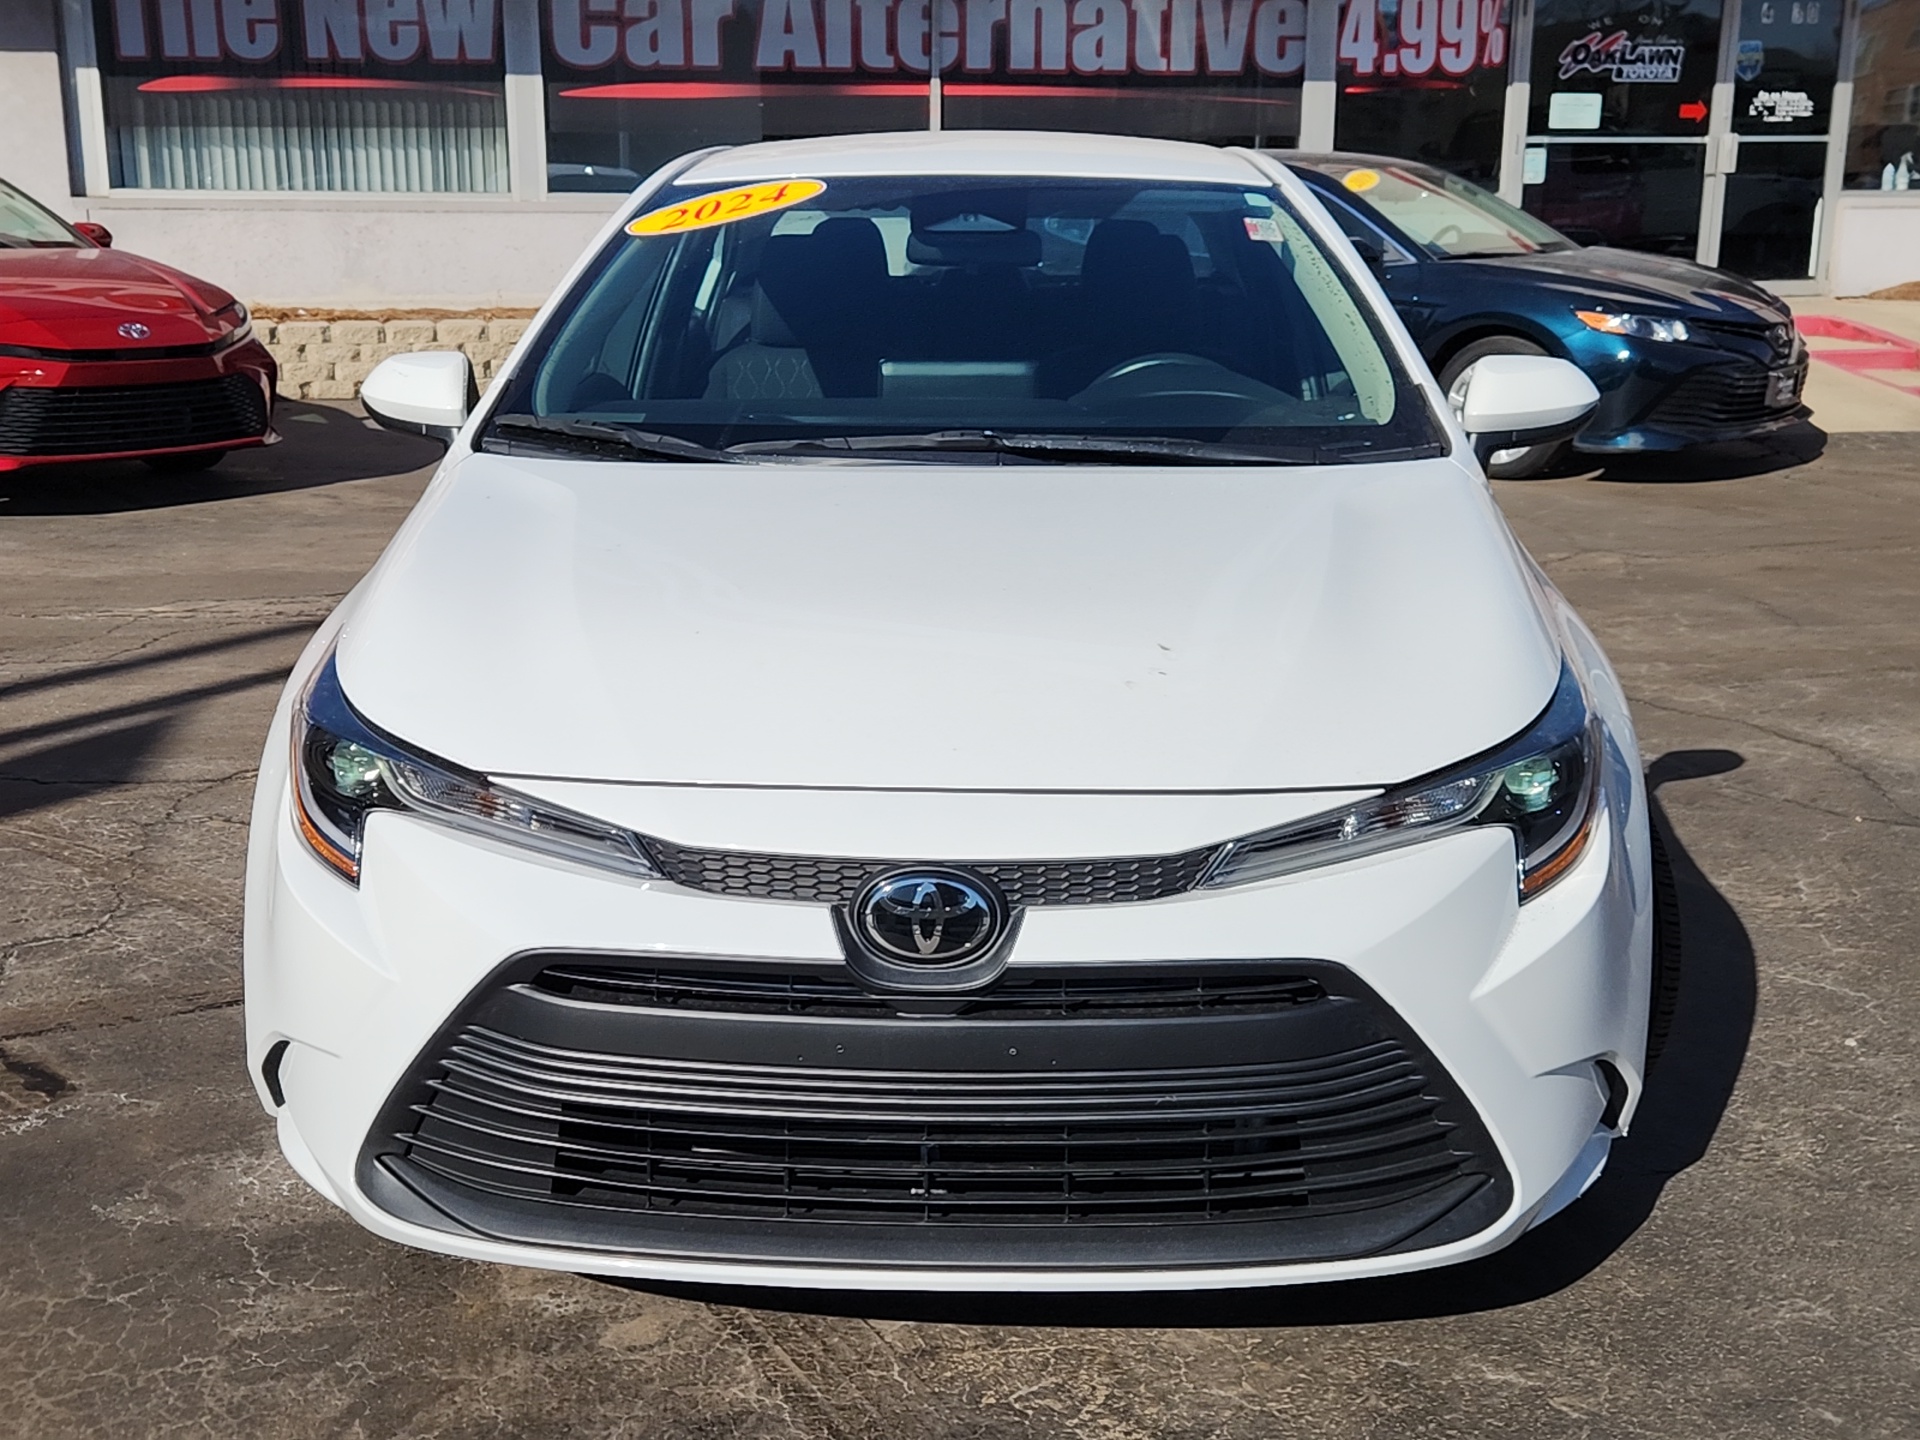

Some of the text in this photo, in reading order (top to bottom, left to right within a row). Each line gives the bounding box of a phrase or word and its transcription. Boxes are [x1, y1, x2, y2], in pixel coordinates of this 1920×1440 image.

[304, 0, 497, 64] New
[551, 0, 737, 70] Car
[755, 0, 1304, 76] Alternative
[1338, 0, 1505, 76] 4.99%
[1621, 66, 1674, 80] TOYOTA
[660, 183, 791, 231] 2024
